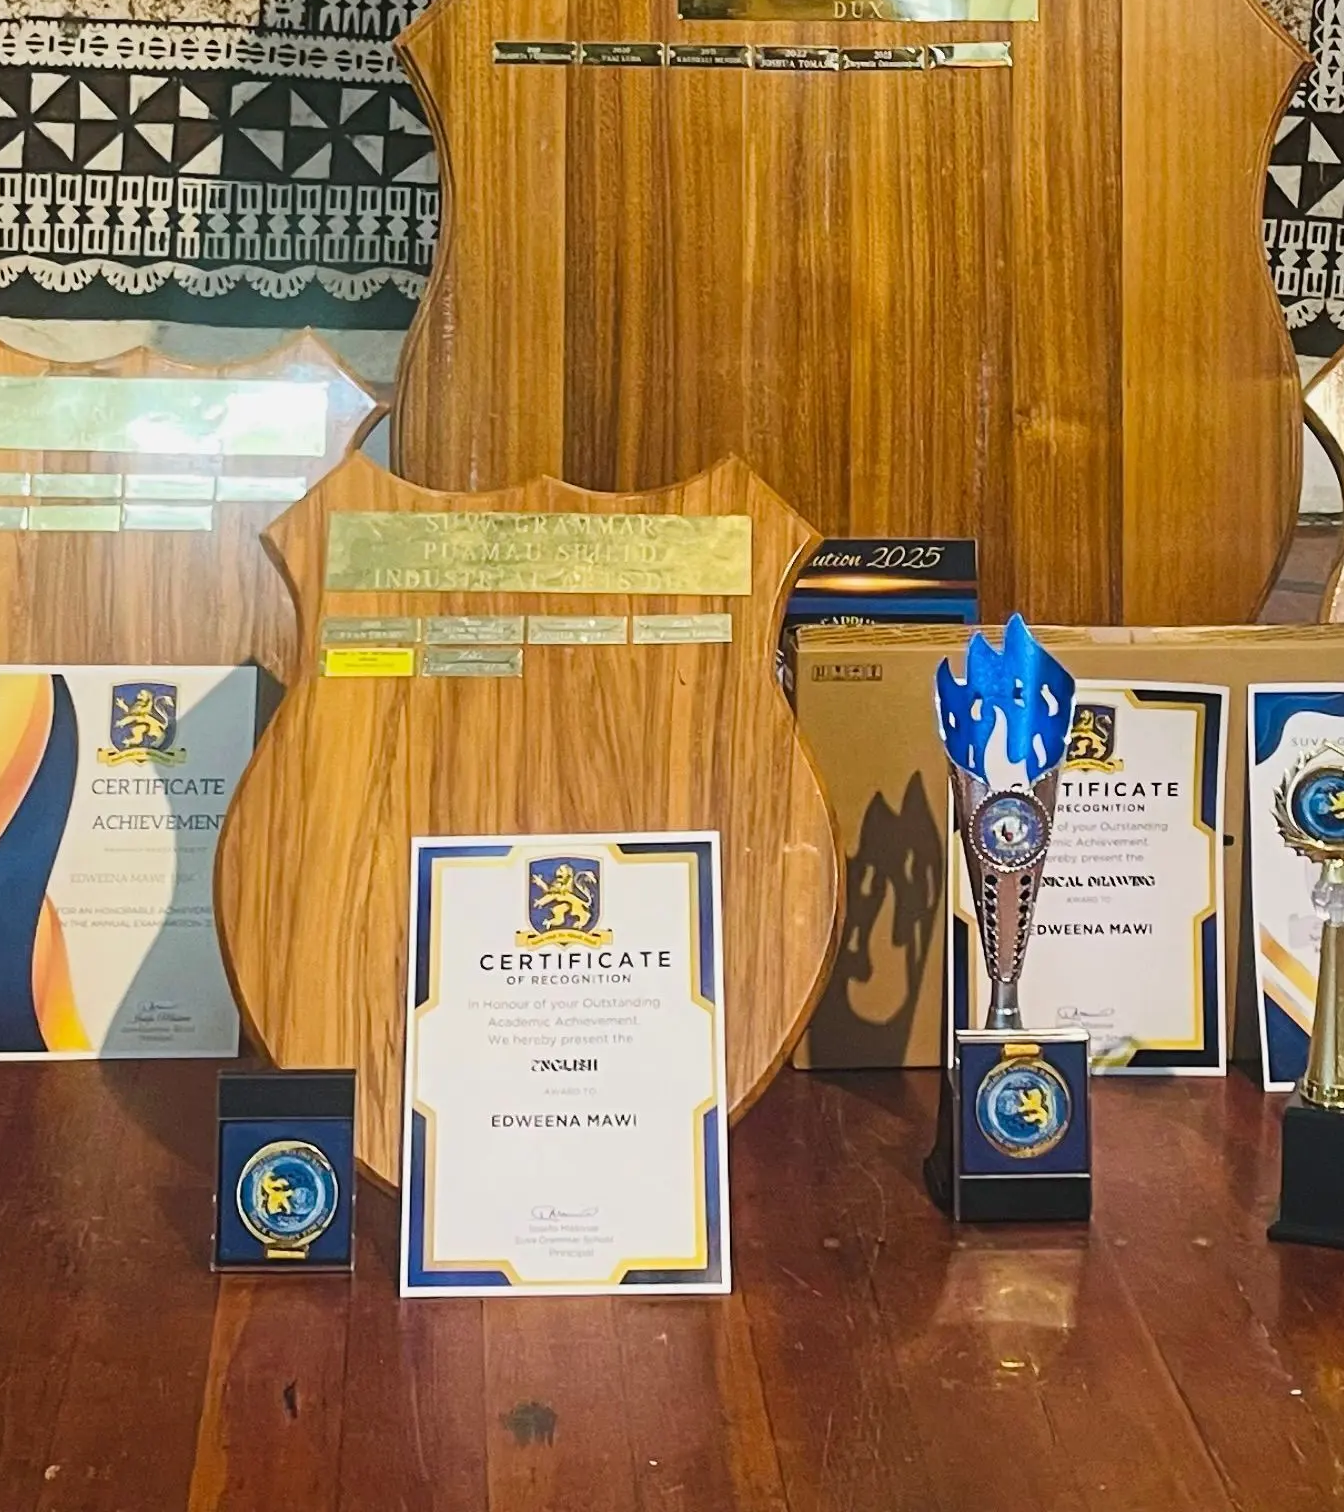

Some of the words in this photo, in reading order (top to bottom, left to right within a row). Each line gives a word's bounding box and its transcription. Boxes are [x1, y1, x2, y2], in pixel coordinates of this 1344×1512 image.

[834, 1, 884, 19] DUX
[515, 516, 658, 535] GRAMMAR
[866, 546, 945, 568] 2025
[92, 779, 225, 795] CERTIFICATE
[1057, 804, 1145, 813] RECOGNITION
[1088, 876, 1156, 887] DRAWING
[1030, 924, 1104, 935] EDWEENA
[1110, 923, 1153, 935] MAWI
[480, 951, 671, 970] CERTIFICATE
[507, 976, 525, 986] OF
[532, 974, 632, 984] RECOGNITION
[534, 999, 546, 1009] of
[551, 1000, 578, 1011] your
[583, 997, 661, 1010] Outstanding
[488, 1017, 550, 1027] Academic
[491, 1114, 580, 1127] EDWEENA
[588, 1114, 636, 1127] MAWI
